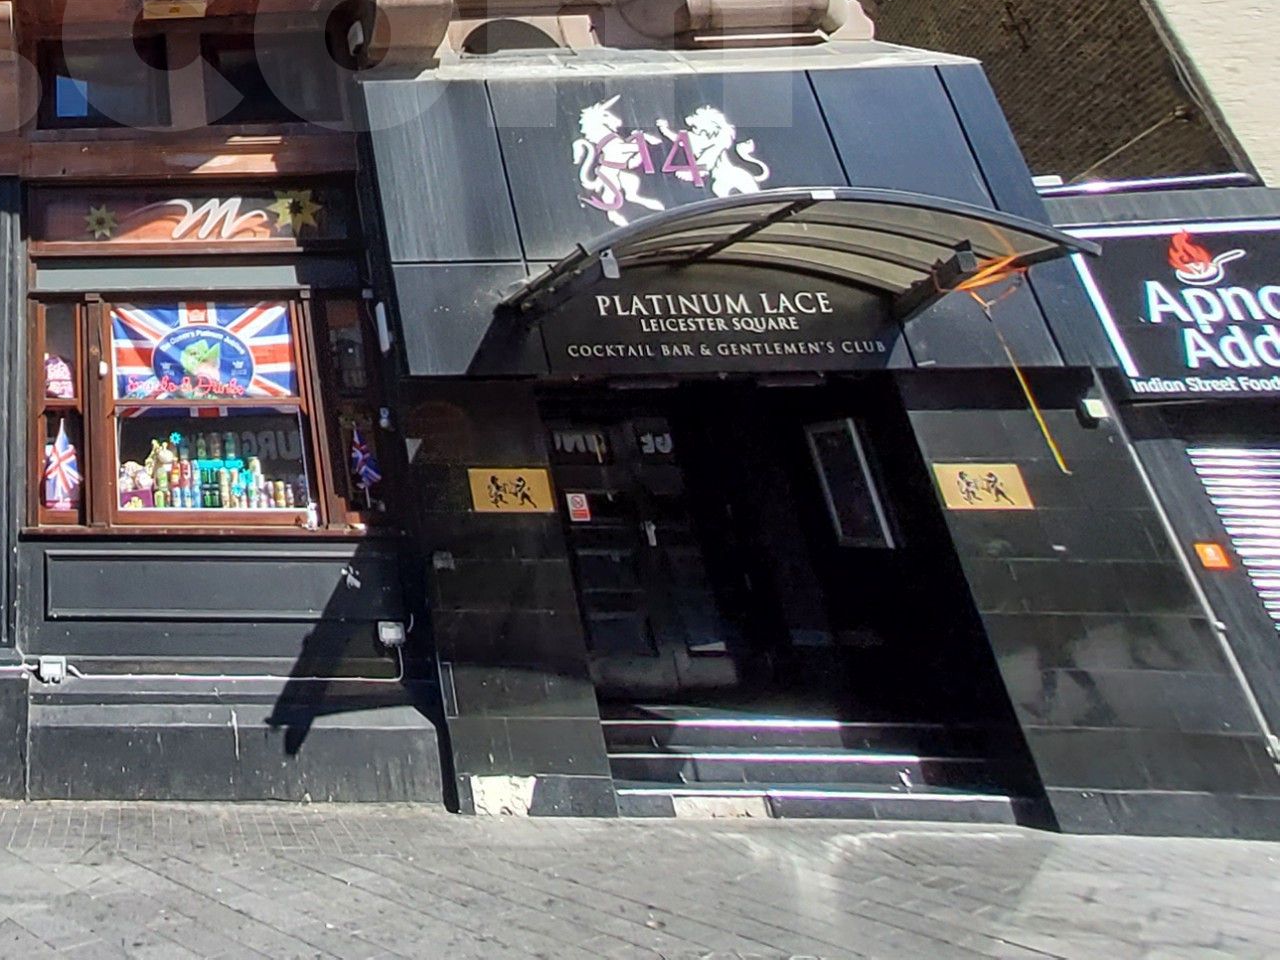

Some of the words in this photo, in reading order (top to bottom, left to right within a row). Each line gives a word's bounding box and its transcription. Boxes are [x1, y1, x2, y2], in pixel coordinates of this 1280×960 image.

[595, 292, 752, 316] PLATINUM
[759, 291, 834, 315] LACE
[640, 317, 729, 333] LEICESTER
[731, 315, 799, 333] SQUARE
[567, 343, 654, 358] COCKTAIL
[661, 343, 694, 357] BAR
[699, 343, 713, 356] &
[717, 341, 835, 357] GENTLEMEN'S
[841, 340, 887, 354] CLUB
[1130, 377, 1186, 394] Indian
[1185, 376, 1239, 393] Street
